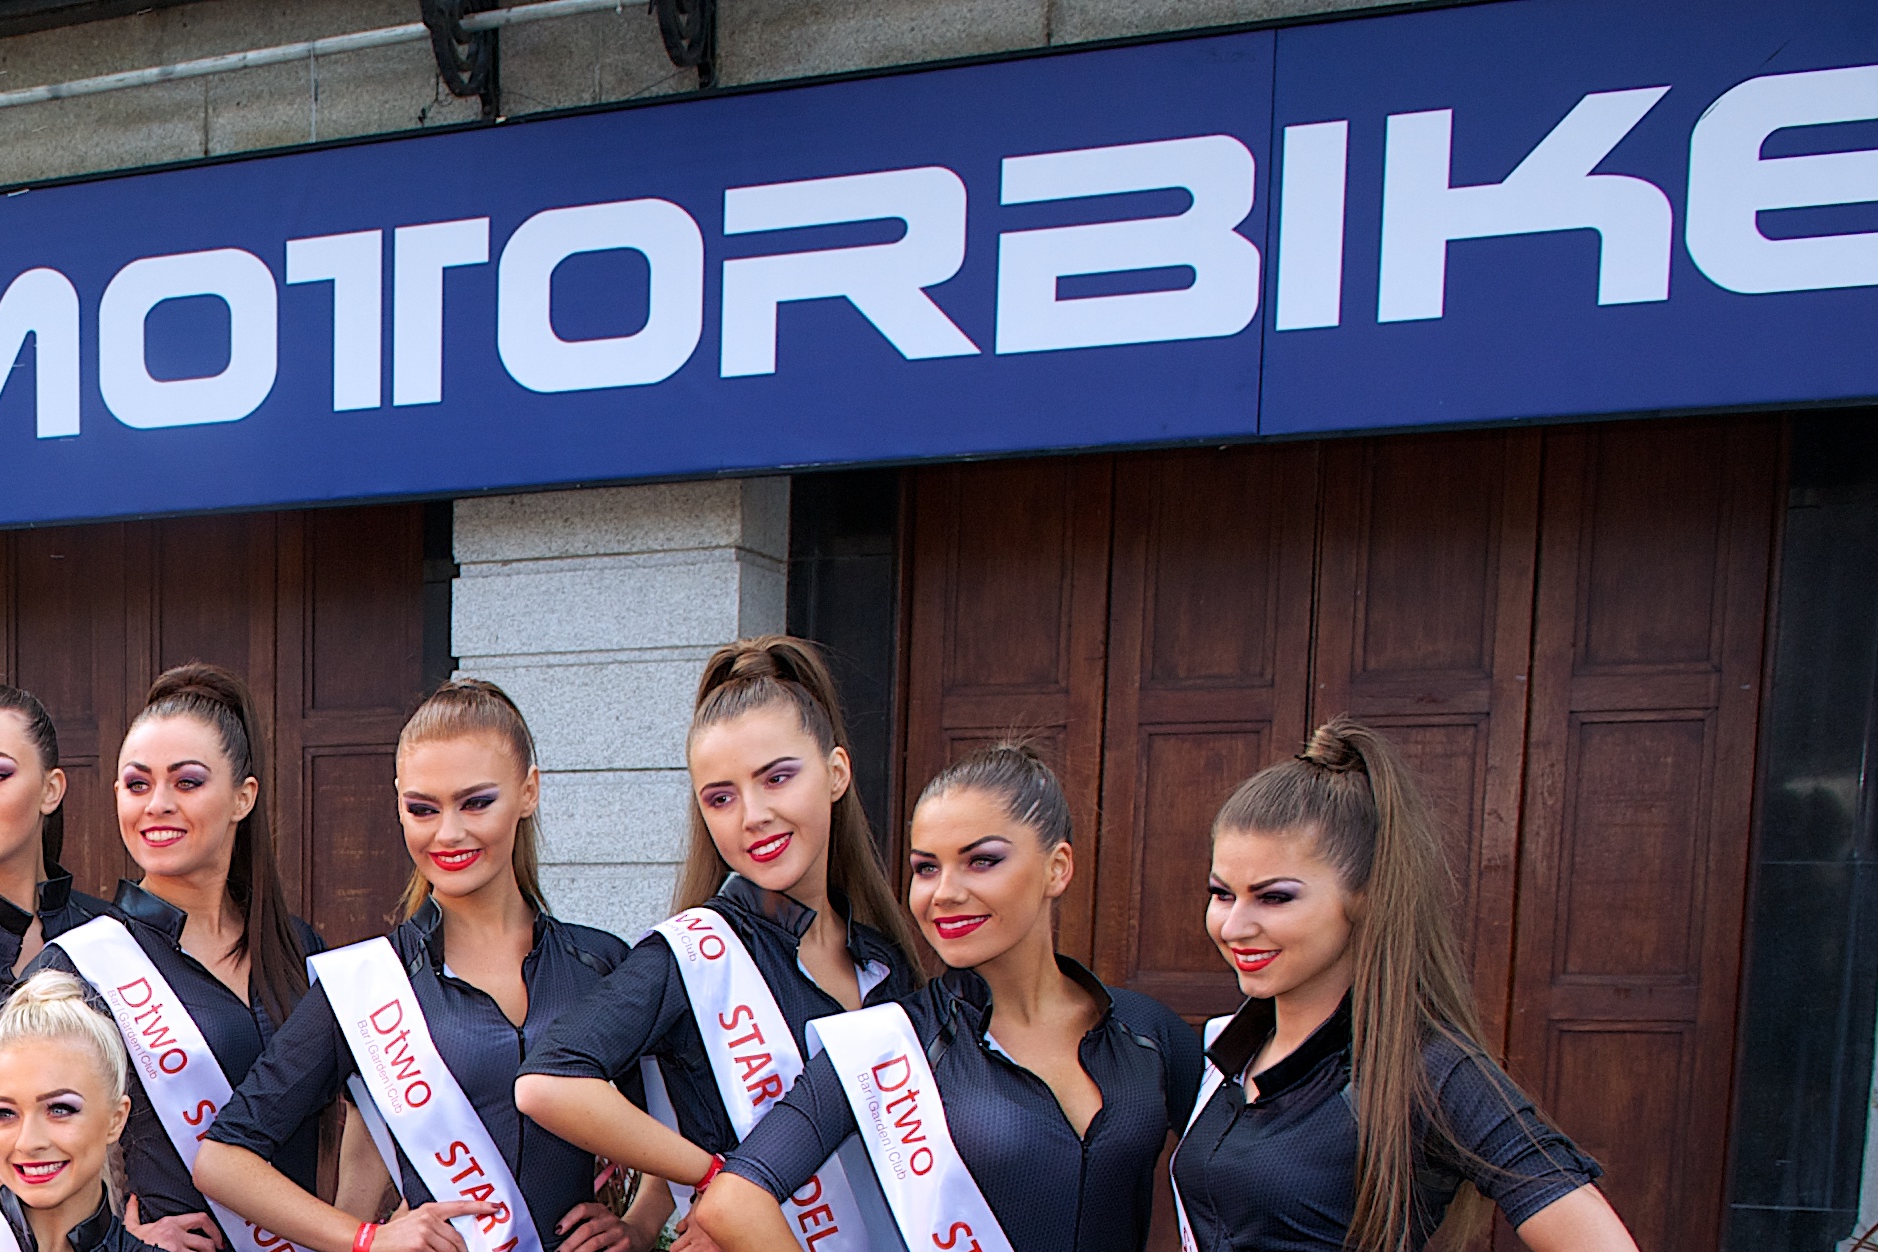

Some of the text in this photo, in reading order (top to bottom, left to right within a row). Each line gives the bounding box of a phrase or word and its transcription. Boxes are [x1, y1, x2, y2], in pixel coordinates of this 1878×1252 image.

[675, 914, 726, 961] wo
[681, 935, 697, 962] Club
[117, 976, 188, 1075] Dtwo
[369, 998, 432, 1109] Dtwo
[718, 1004, 783, 1107] STAR
[871, 1053, 934, 1177] Dtwo
[435, 1140, 511, 1235] STAR
